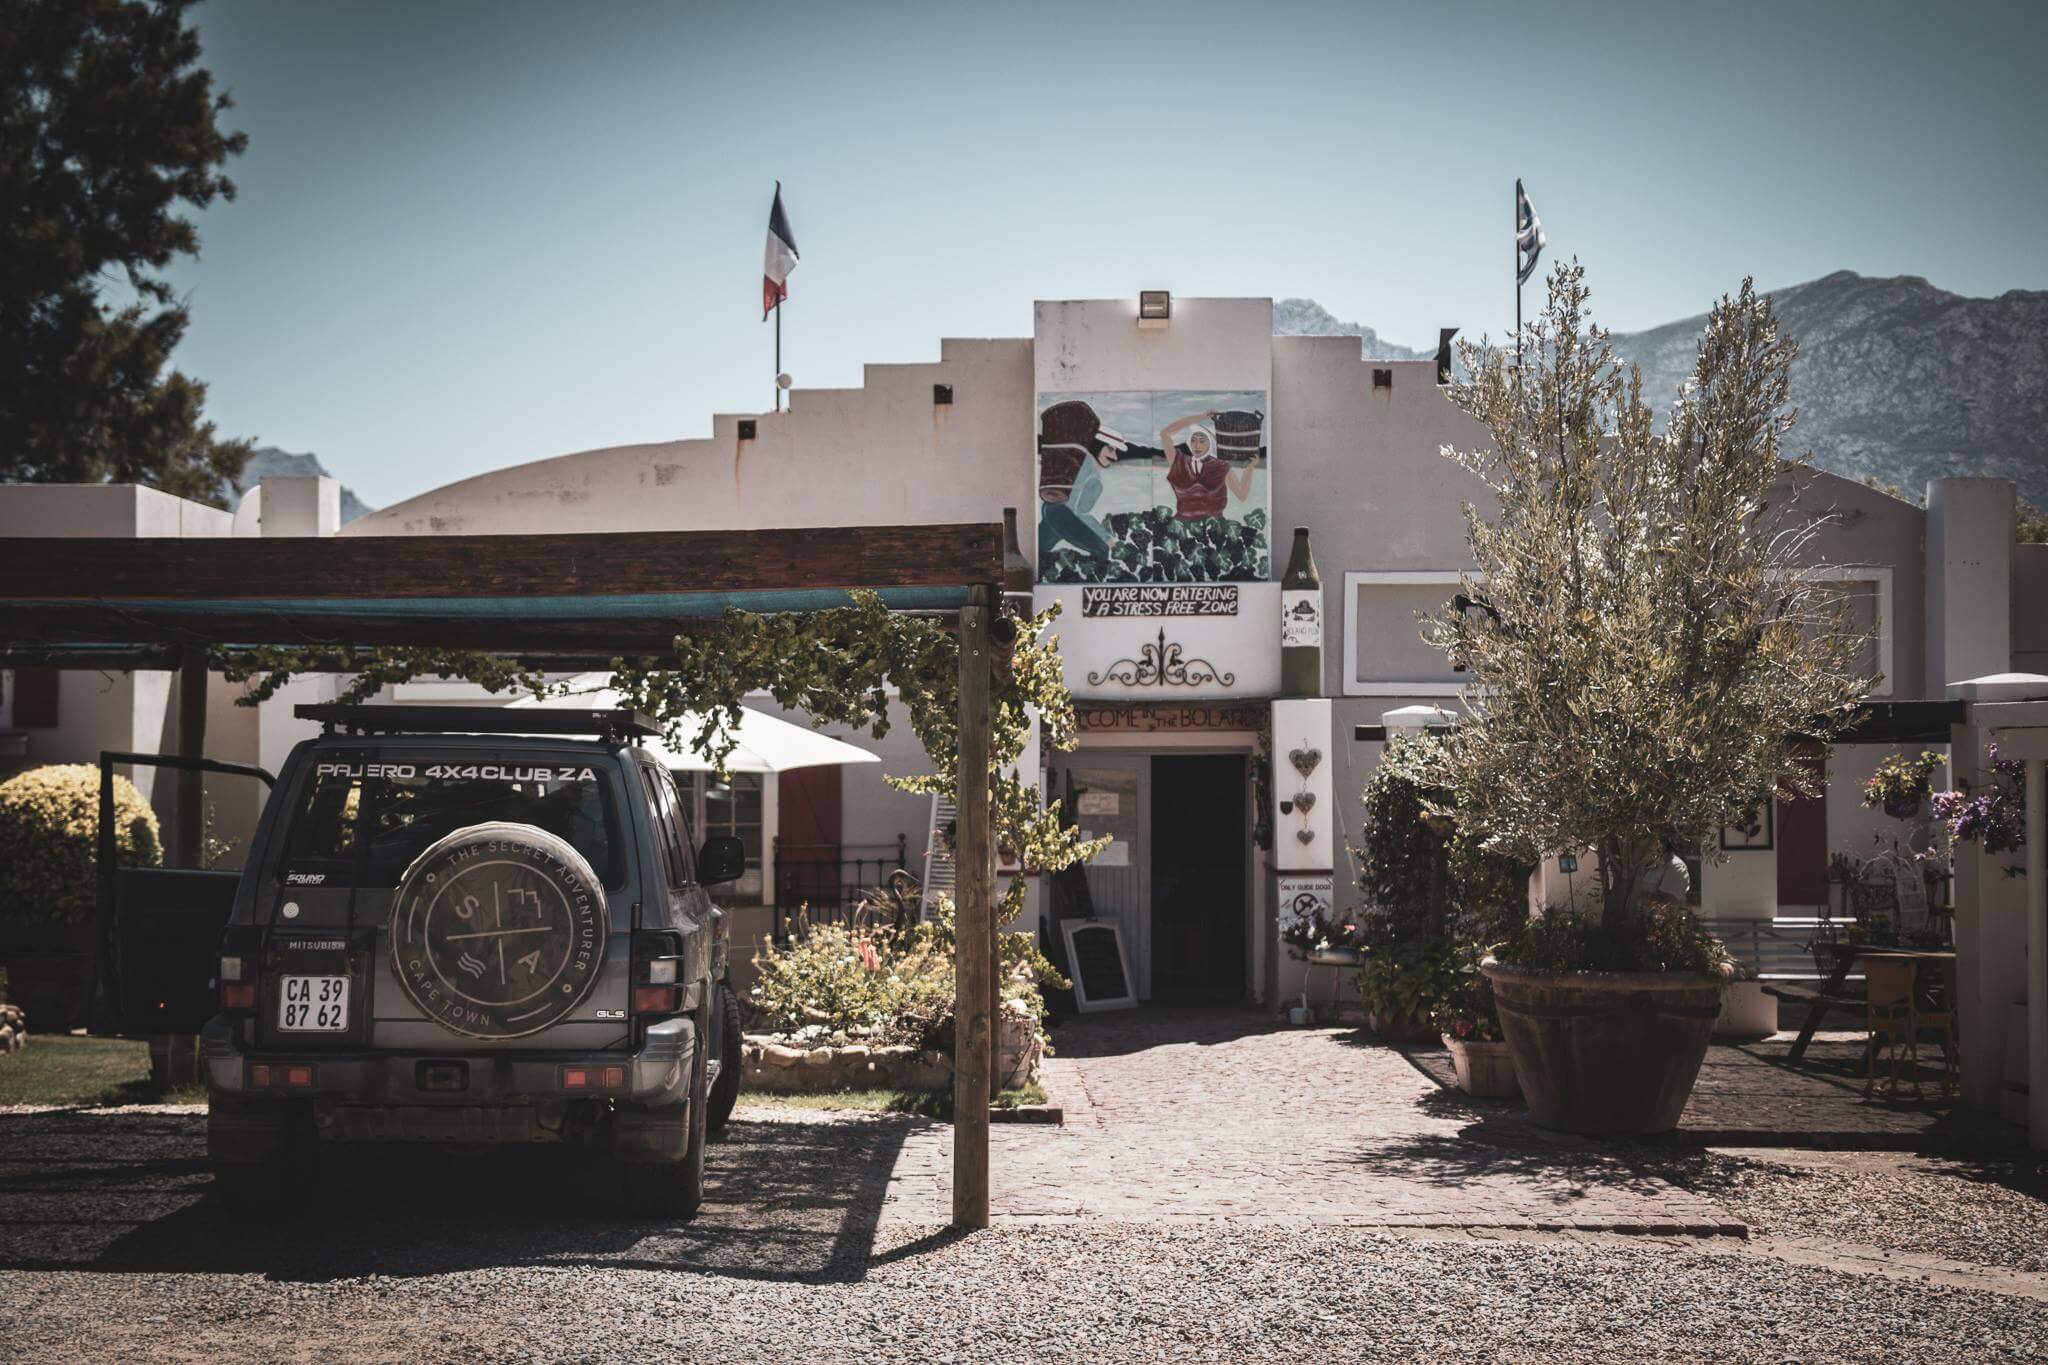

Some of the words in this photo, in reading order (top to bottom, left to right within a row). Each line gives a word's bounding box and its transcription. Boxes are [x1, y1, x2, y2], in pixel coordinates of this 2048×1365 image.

[1140, 587, 1168, 601] NOW
[1173, 587, 1237, 601] ENTERING
[1113, 601, 1162, 616] STRESS
[1165, 601, 1197, 616] FREE
[1079, 709, 1140, 728] LCOME
[316, 763, 416, 779] PAJERO
[558, 767, 597, 782] ZA
[447, 845, 480, 866] THE
[488, 841, 554, 865] SECRET
[555, 866, 594, 971] ADVENTURER
[287, 979, 310, 1001] CA
[319, 979, 343, 1002] 39
[409, 959, 440, 1001] CAPE
[443, 1000, 490, 1026] TOWN
[285, 1004, 309, 1027] 87
[317, 1004, 341, 1027] 62
[596, 1010, 625, 1018] GLS
